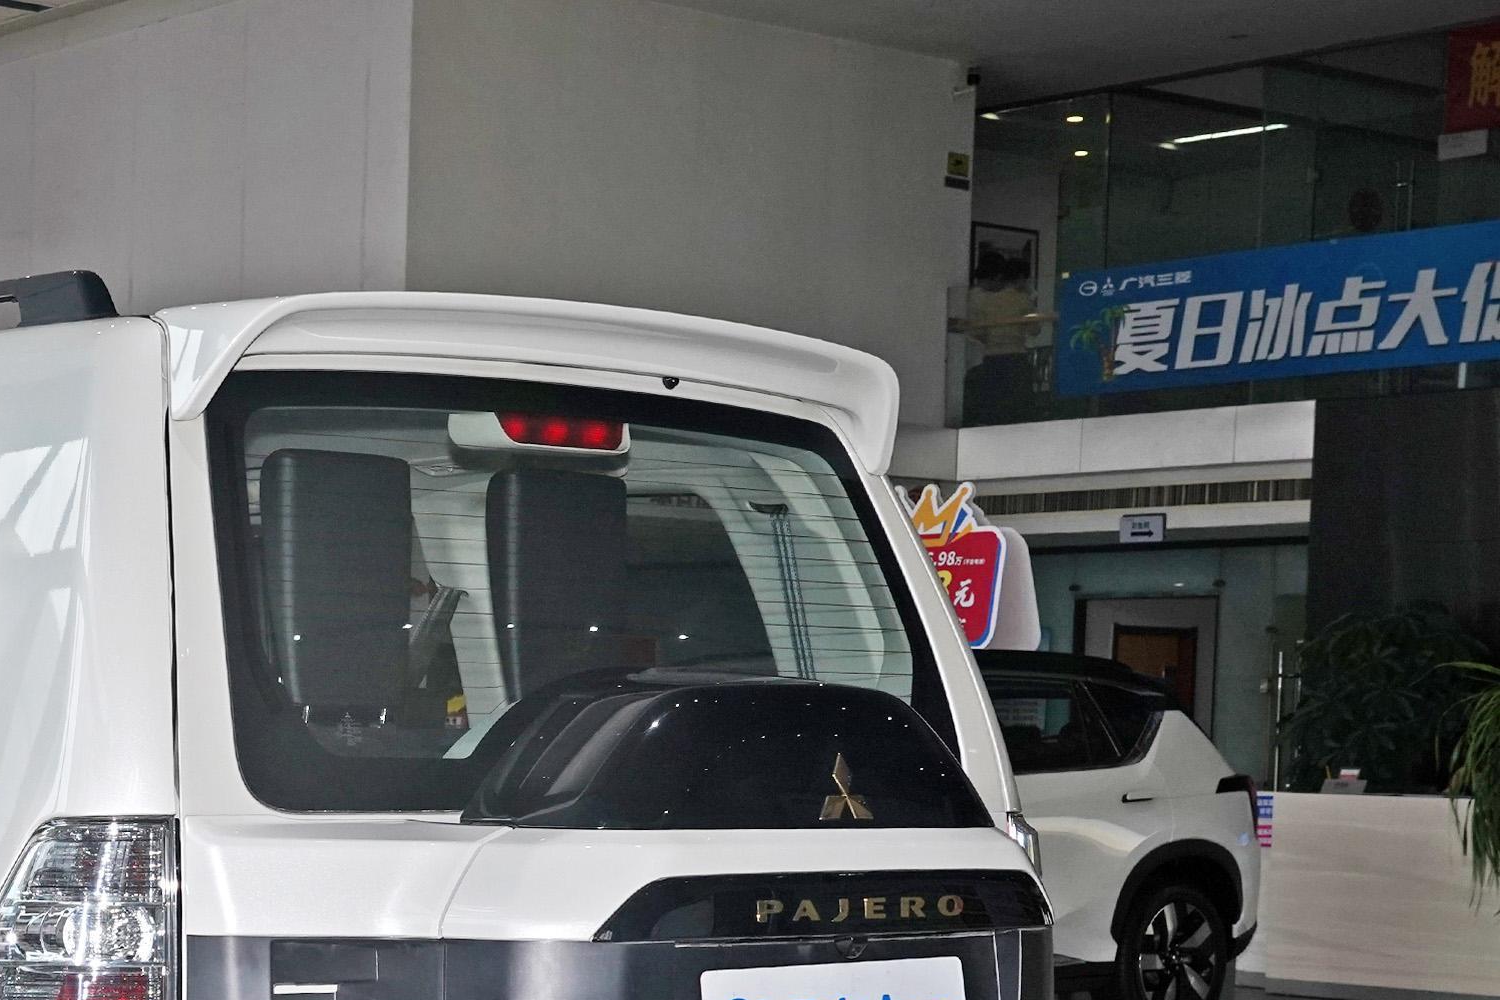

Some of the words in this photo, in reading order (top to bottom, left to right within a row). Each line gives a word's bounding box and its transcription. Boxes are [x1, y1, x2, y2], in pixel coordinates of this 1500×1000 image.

[1119, 270, 1192, 291] 广汽三菱
[756, 894, 965, 923] PAJERO
